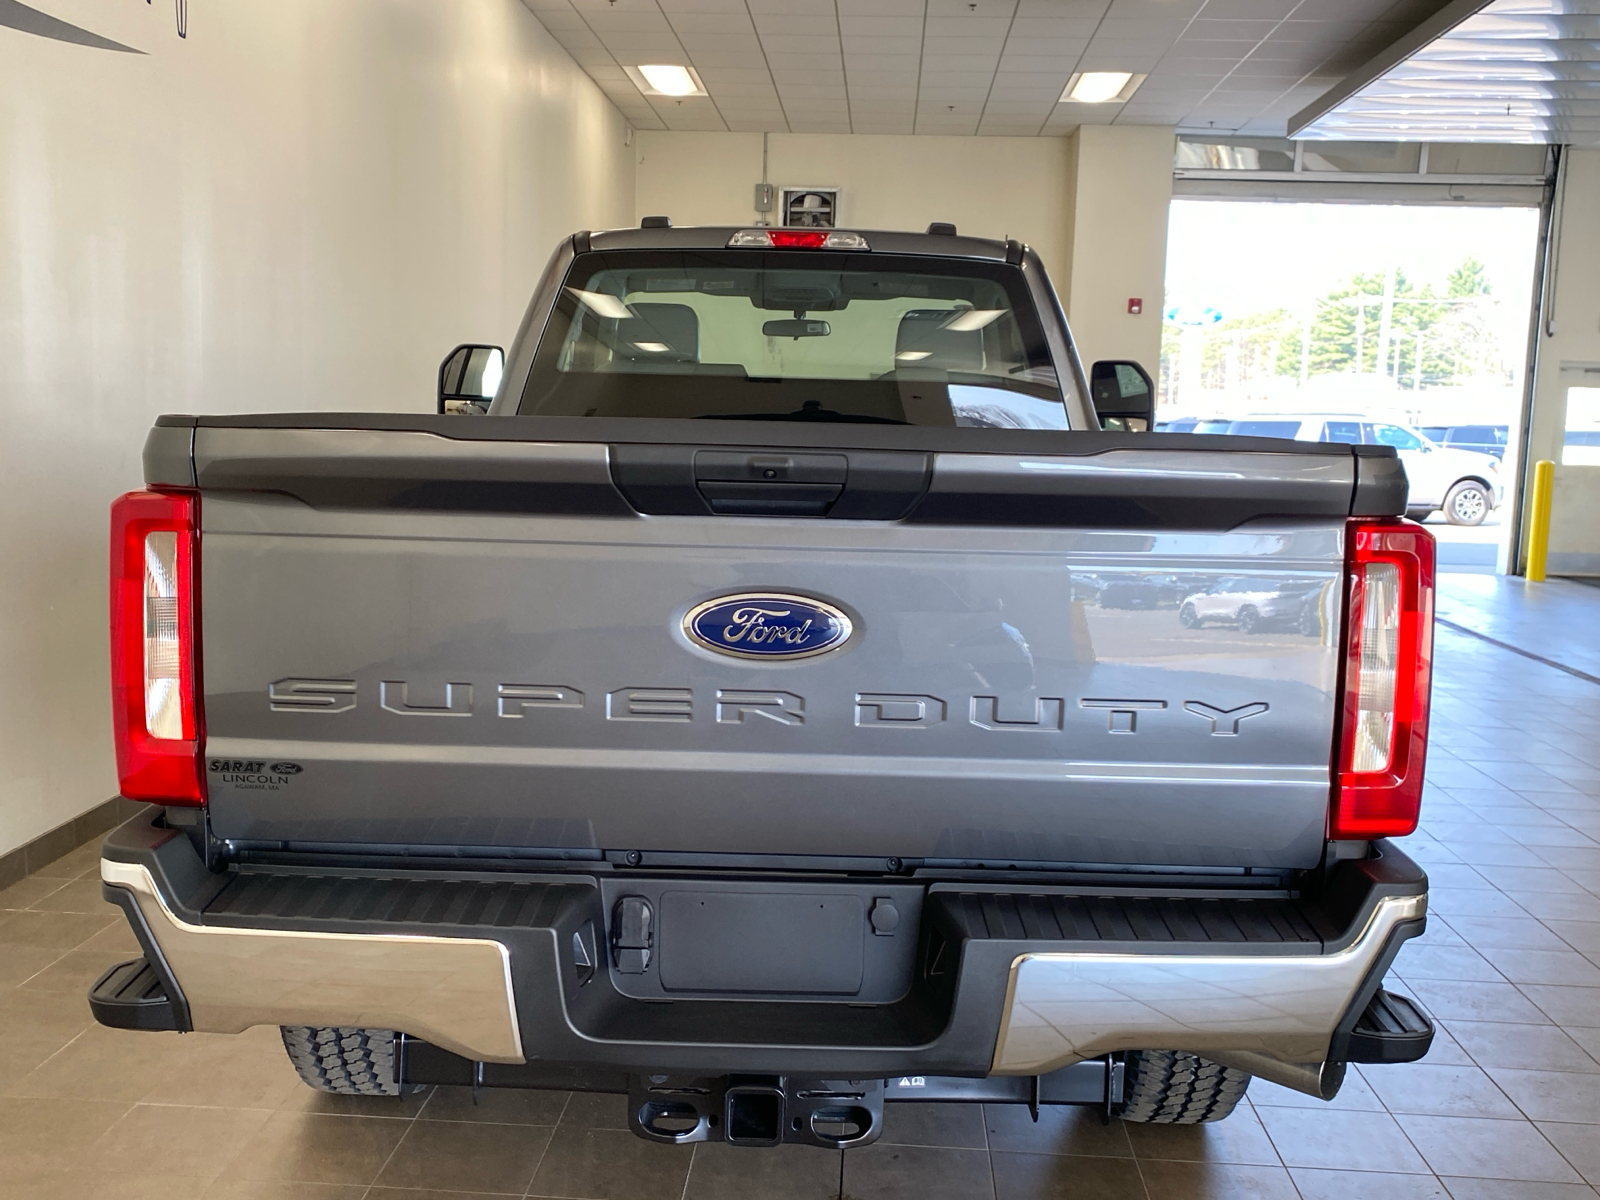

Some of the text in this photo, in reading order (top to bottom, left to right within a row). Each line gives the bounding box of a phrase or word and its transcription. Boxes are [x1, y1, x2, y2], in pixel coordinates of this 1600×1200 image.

[723, 607, 811, 644] Ford
[269, 677, 1270, 737] SUPER DUTY
[209, 760, 298, 774] SARAT Ford
[222, 774, 289, 784] LINCOLN
